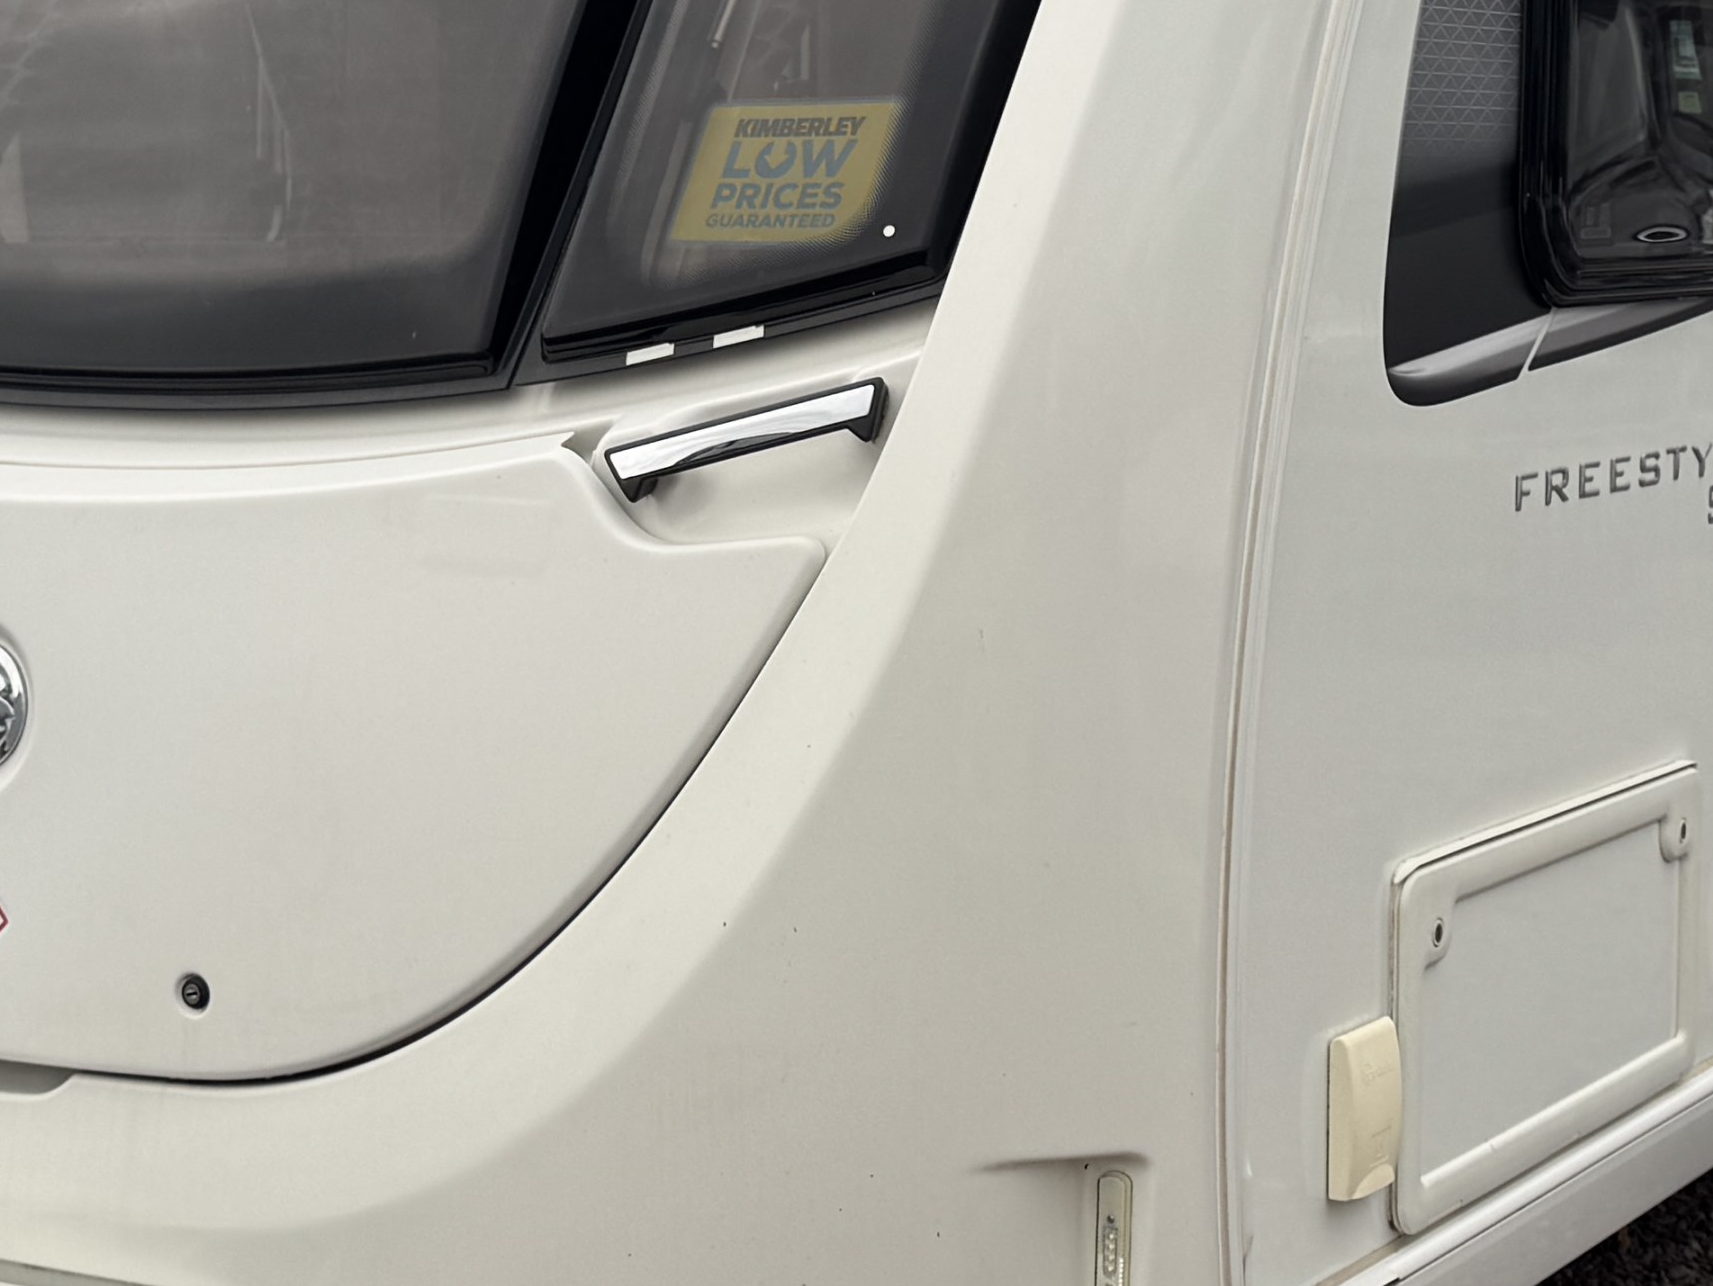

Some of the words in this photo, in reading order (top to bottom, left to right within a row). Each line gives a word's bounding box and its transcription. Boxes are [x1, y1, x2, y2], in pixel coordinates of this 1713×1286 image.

[735, 116, 866, 139] KIMBERLEY
[721, 139, 859, 179] LOW
[710, 182, 844, 210] PRICES
[706, 214, 836, 229] GUARANTEED
